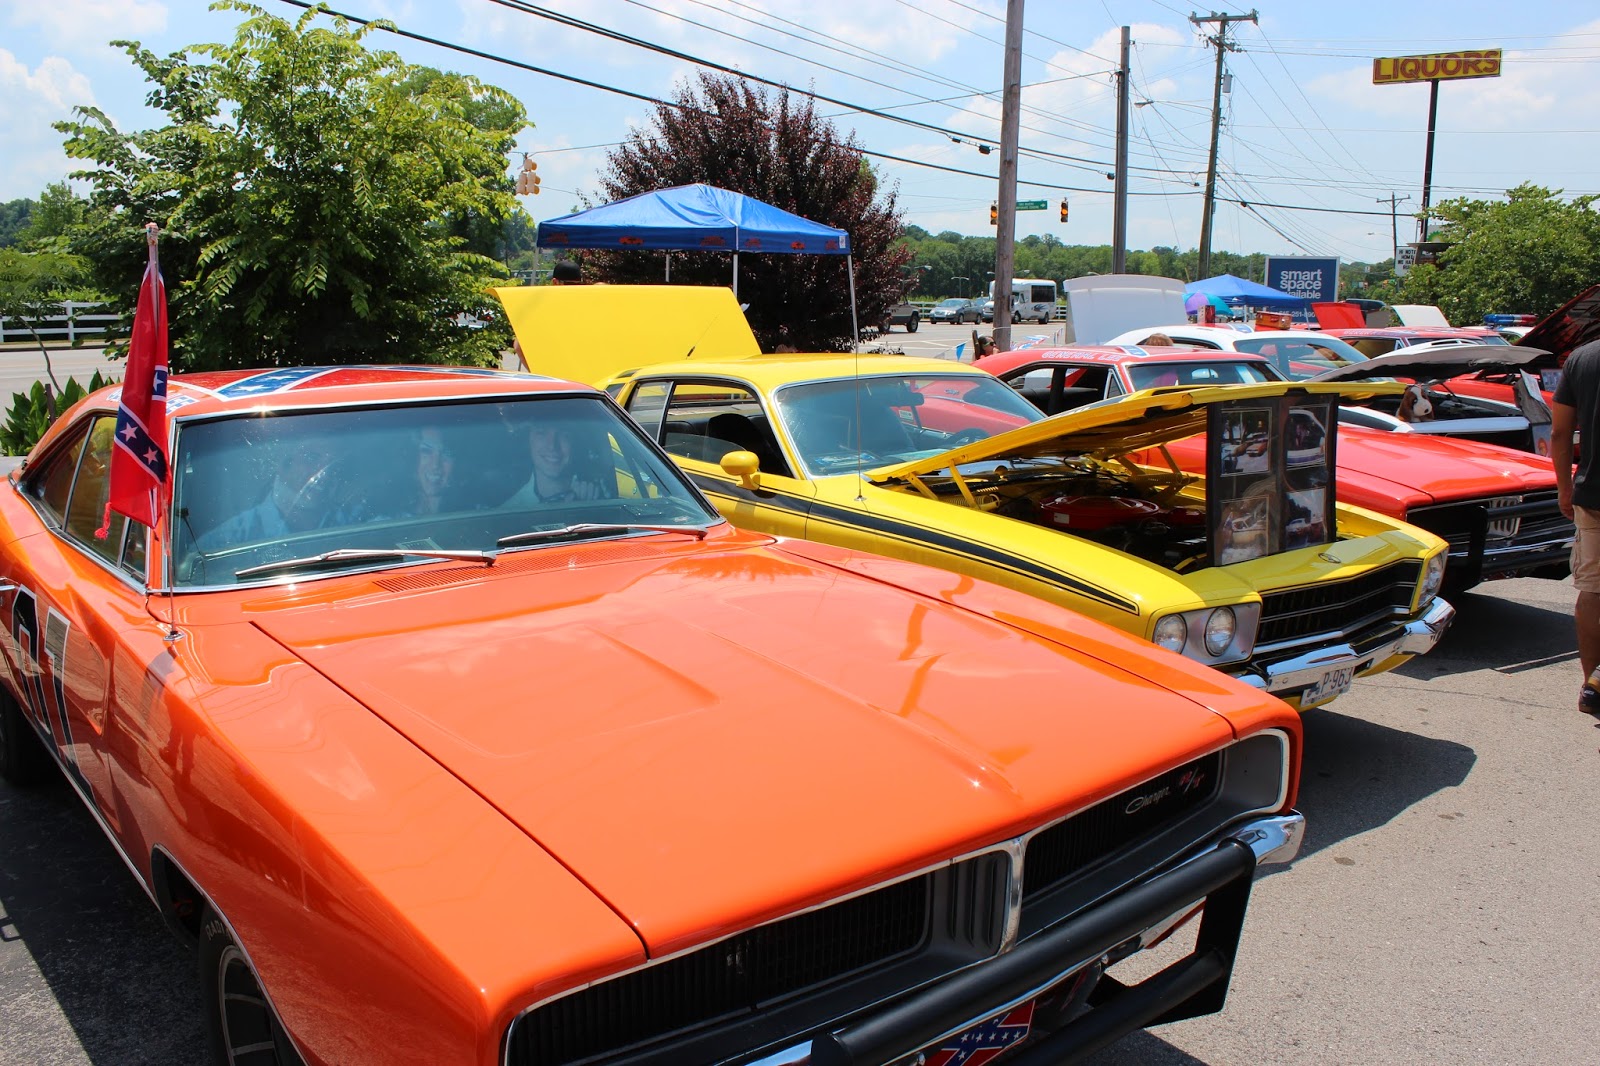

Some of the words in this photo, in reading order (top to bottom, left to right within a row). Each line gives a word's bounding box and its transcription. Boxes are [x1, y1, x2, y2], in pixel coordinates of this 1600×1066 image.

[1374, 50, 1499, 80] LIQUORS
[1280, 269, 1322, 280] smart
[1280, 280, 1322, 292] space
[1286, 290, 1321, 299] vailable
[1125, 786, 1170, 814] Charger
